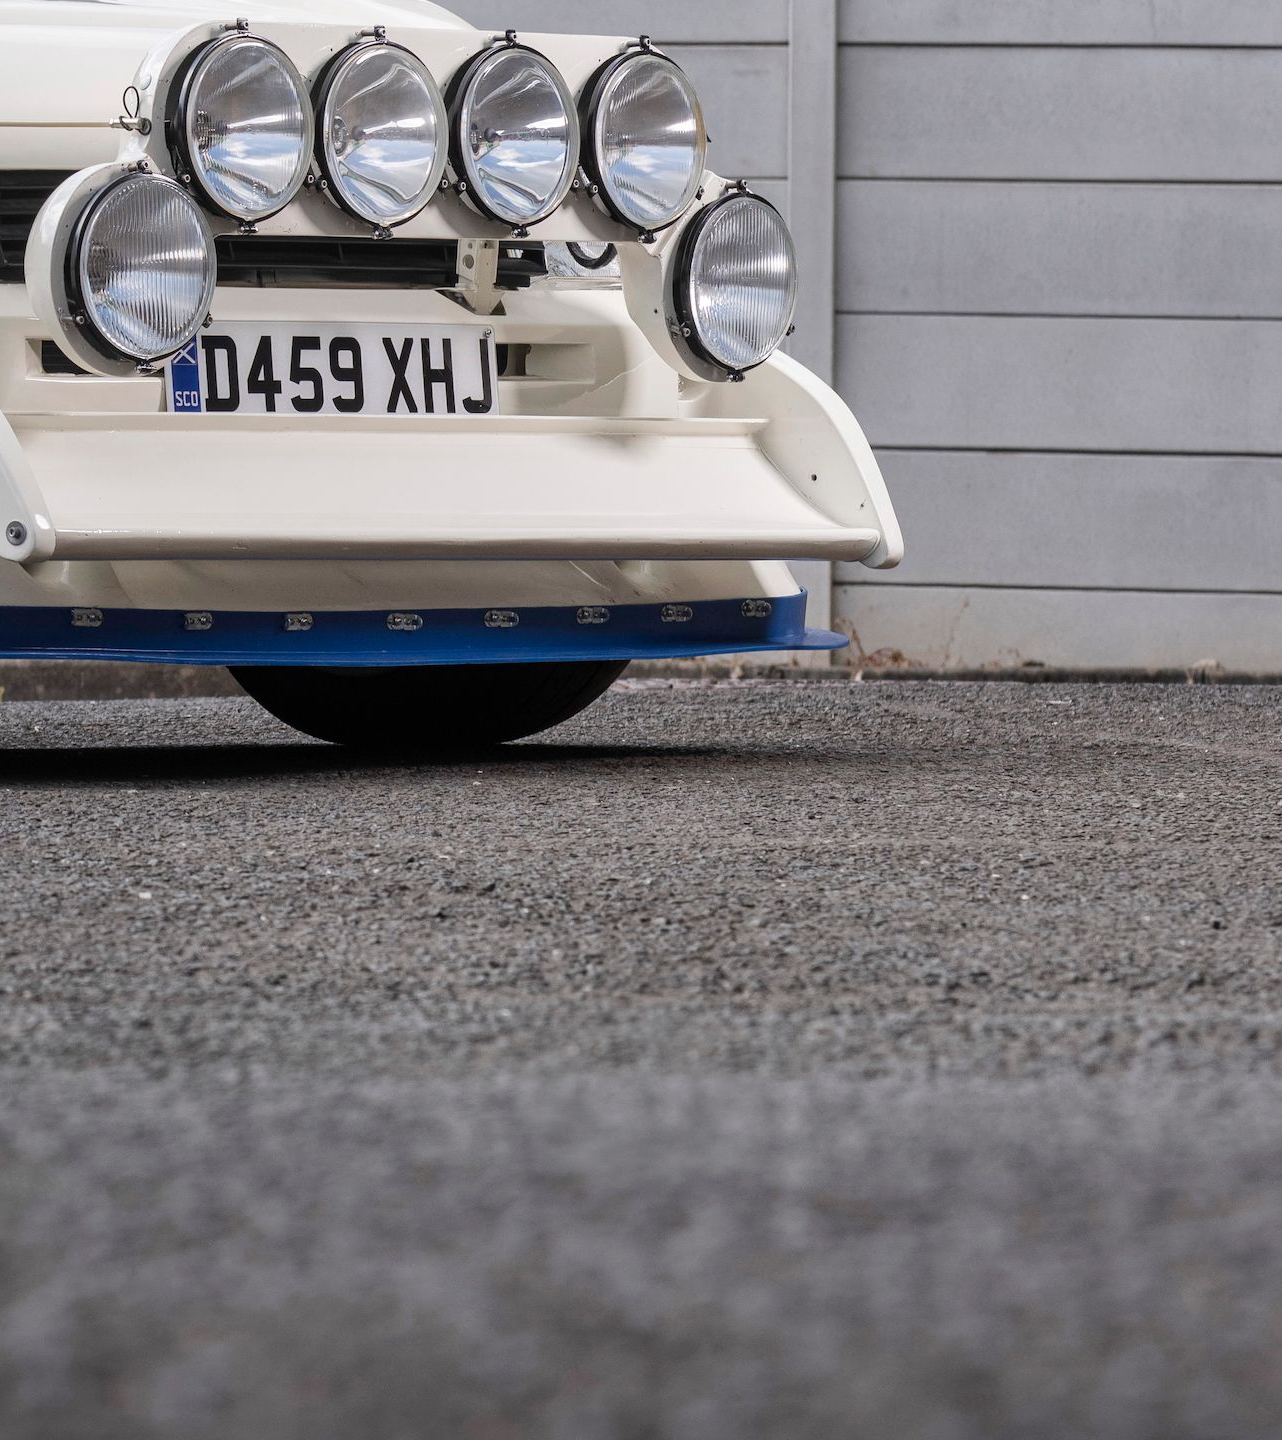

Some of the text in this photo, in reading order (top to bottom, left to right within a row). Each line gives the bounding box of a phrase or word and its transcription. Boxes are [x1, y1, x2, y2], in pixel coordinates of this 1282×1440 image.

[201, 335, 492, 413] D459 XHJ
[175, 391, 198, 406] SCO
